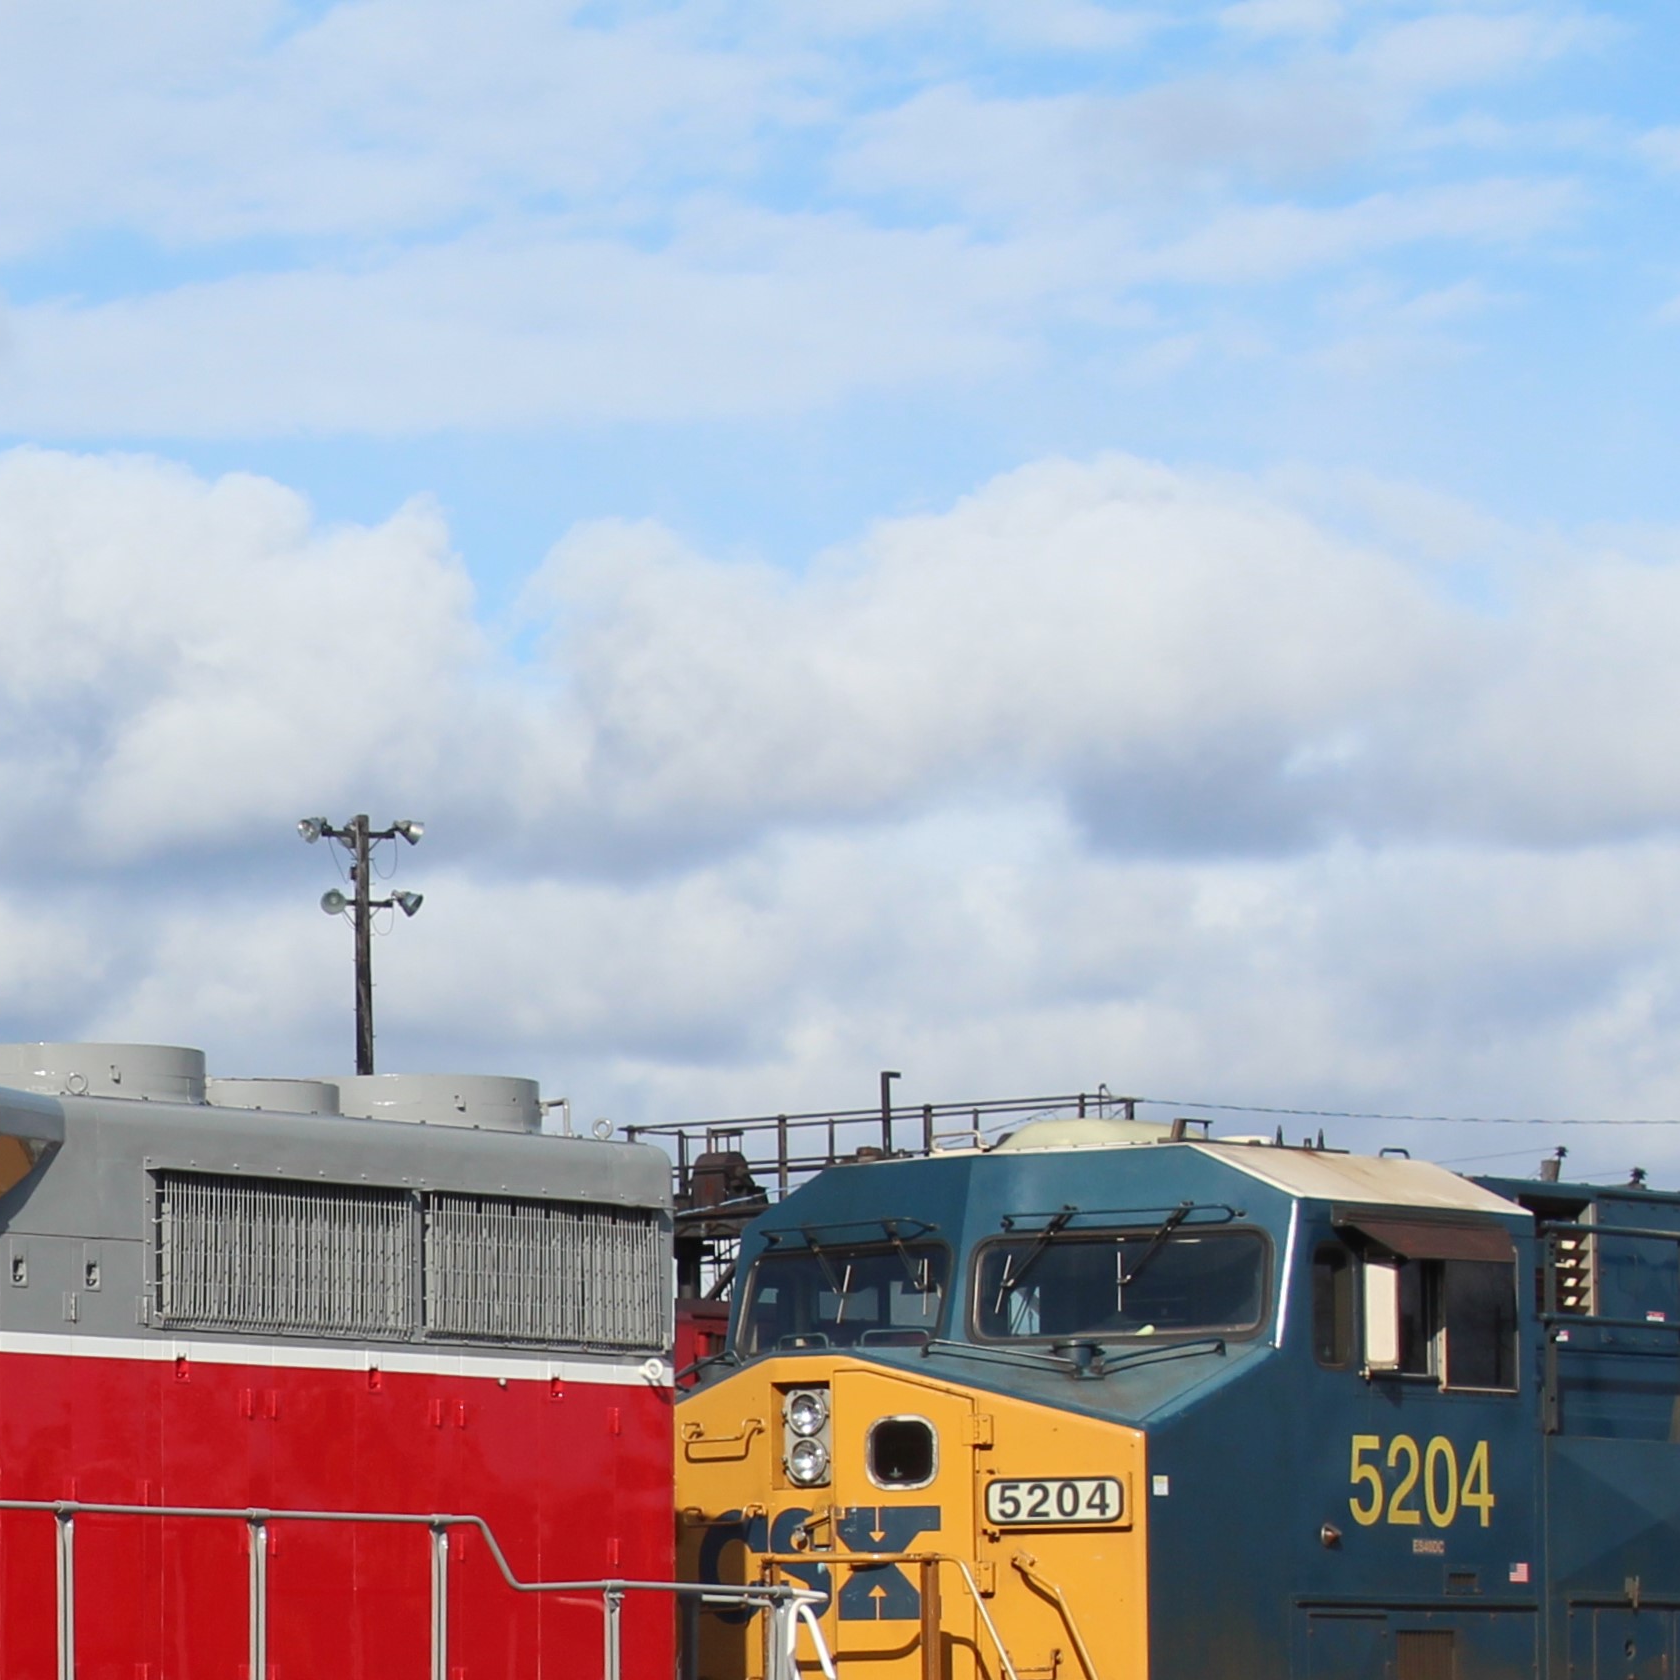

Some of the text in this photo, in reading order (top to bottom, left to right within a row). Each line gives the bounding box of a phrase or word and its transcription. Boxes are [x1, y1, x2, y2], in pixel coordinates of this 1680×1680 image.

[998, 1481, 1110, 1519] 5204
[1349, 1434, 1495, 1528] 5204
[699, 1505, 941, 1625] CSX
